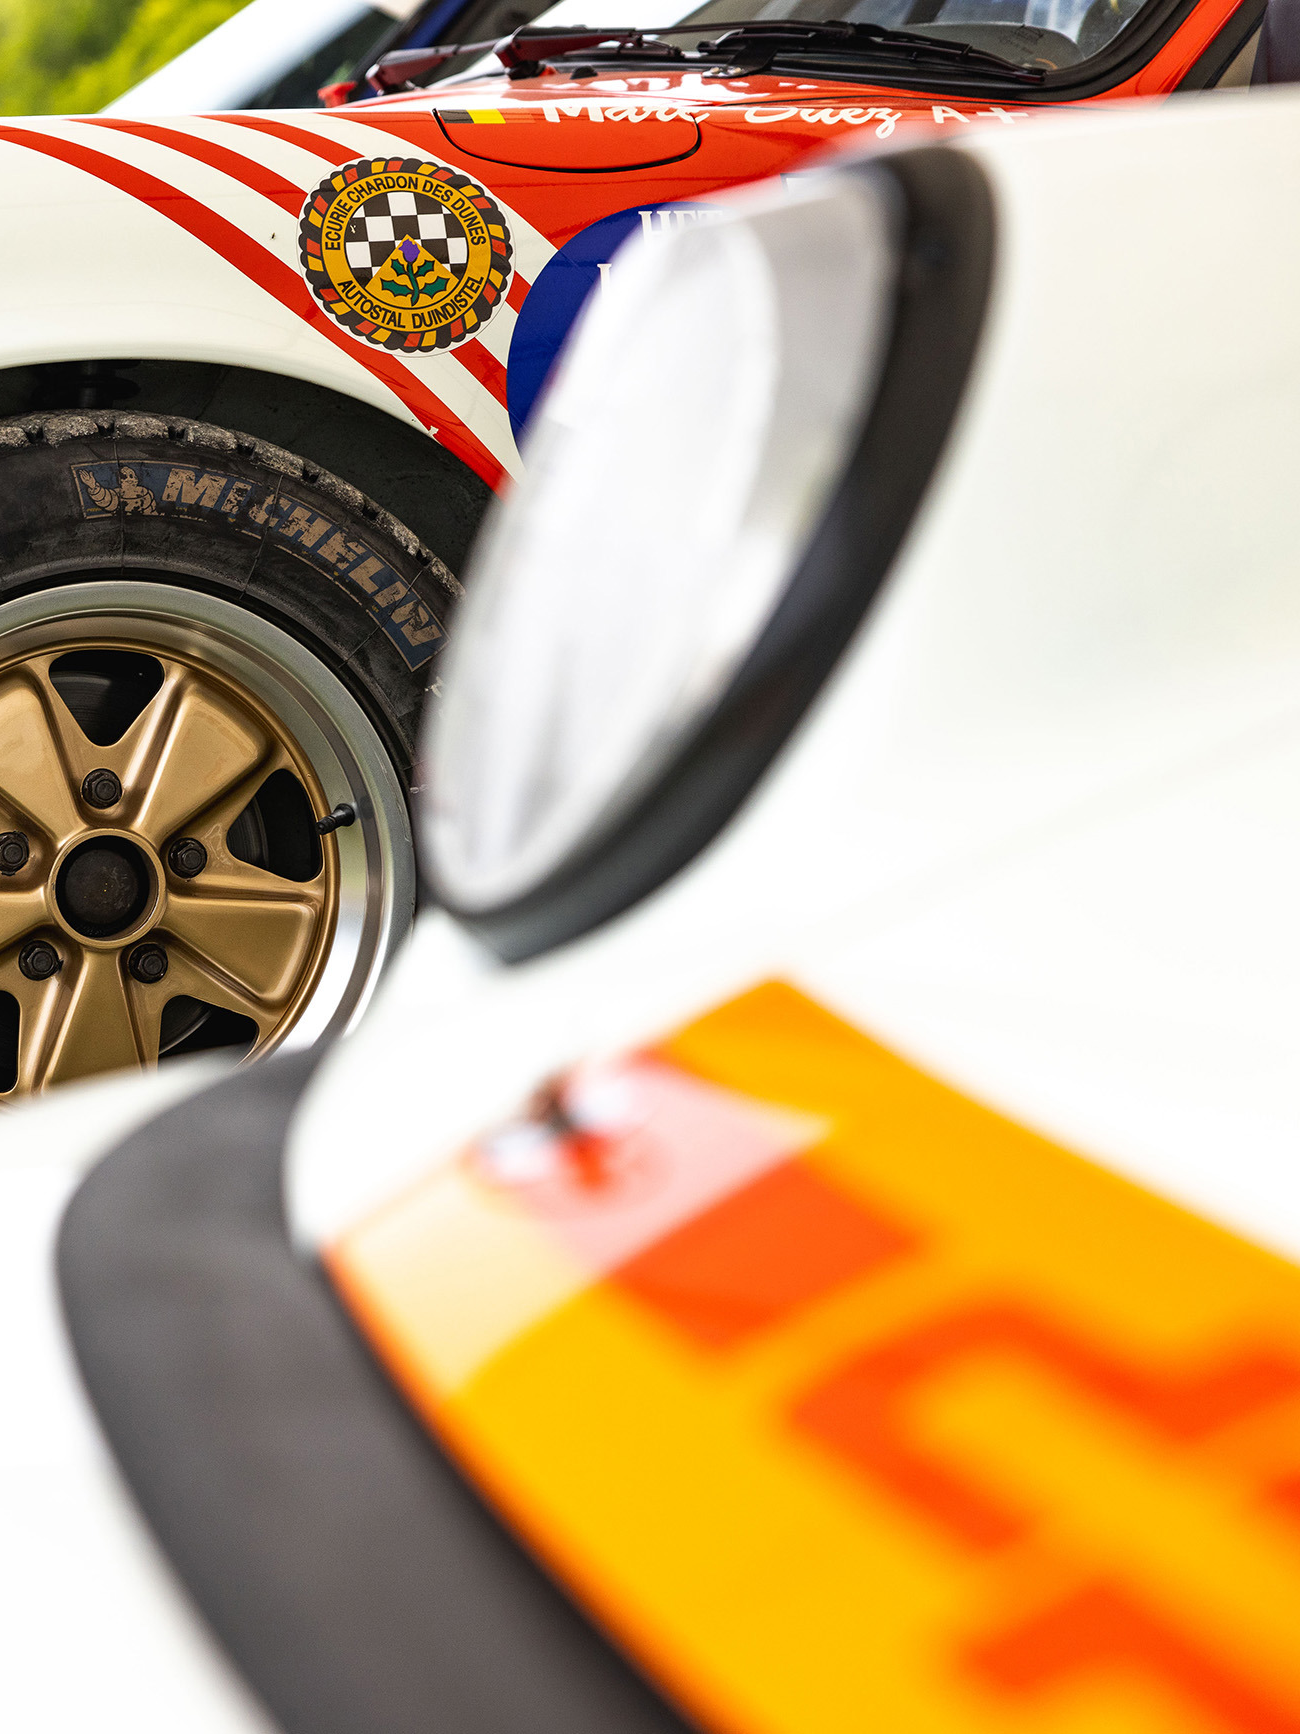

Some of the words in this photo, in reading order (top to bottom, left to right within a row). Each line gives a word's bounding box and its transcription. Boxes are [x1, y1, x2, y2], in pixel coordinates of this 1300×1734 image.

[325, 199, 354, 250] ECURIE
[346, 175, 418, 205] CHARDON
[422, 179, 453, 202] DES
[451, 197, 487, 246] DUNES
[337, 279, 406, 329] AUTOSTAL
[411, 275, 485, 329] DUINDISTEL
[161, 467, 443, 647] MICHELIN
